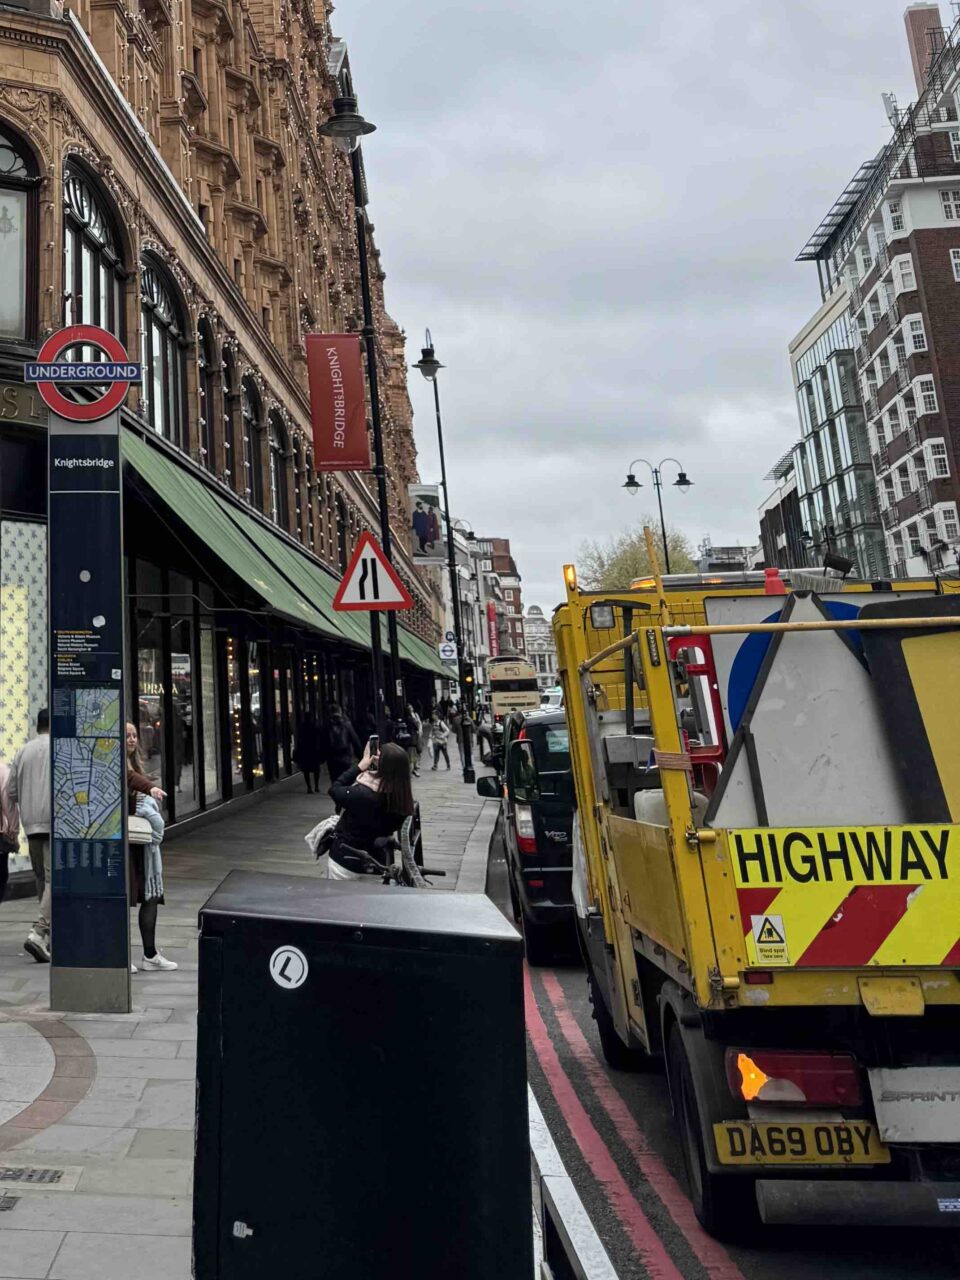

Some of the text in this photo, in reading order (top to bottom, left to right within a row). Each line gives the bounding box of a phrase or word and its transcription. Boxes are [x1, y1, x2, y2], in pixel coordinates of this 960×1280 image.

[29, 365, 138, 378] UNDERGROUND
[326, 347, 346, 449] KNIGHTSBRIDGE
[54, 458, 115, 469] Knightsbridge
[143, 683, 178, 695] PRAA
[734, 829, 950, 883] HIGHWAY
[880, 1090, 960, 1103] SPRINT
[725, 1125, 872, 1157] DA69 OBY
